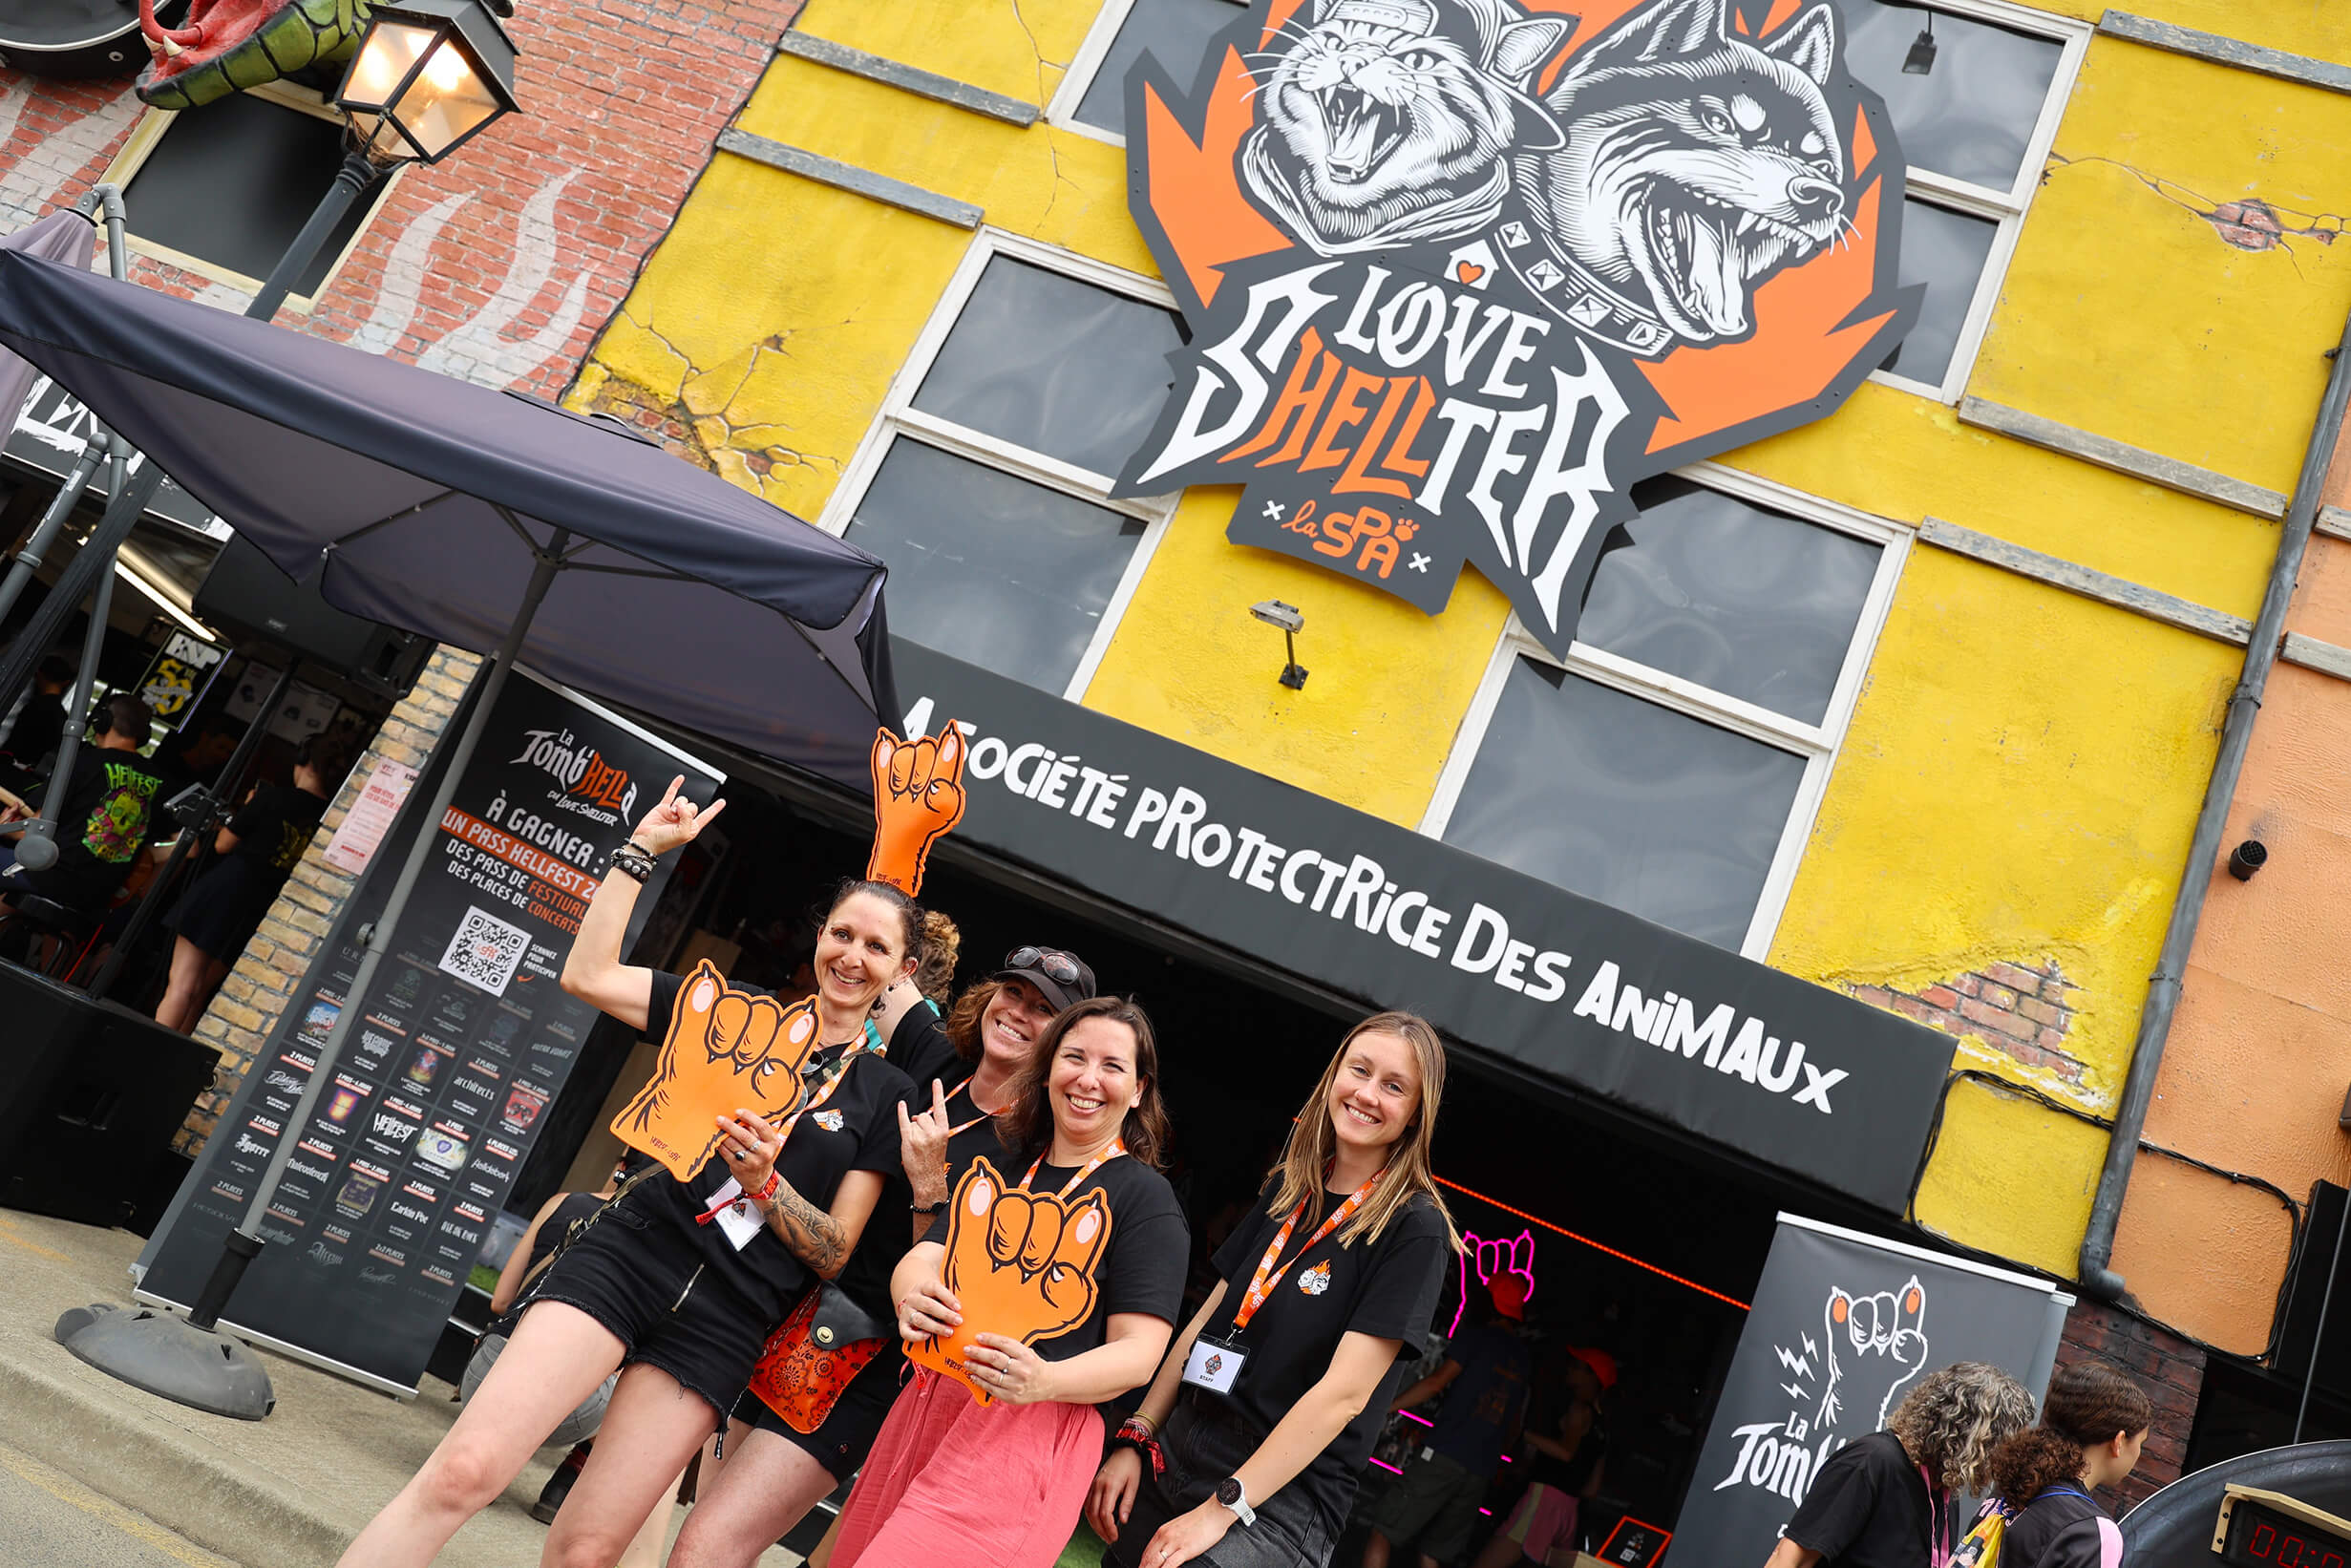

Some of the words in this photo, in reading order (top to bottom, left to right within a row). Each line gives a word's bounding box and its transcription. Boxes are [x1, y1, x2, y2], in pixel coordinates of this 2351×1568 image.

[1334, 264, 1551, 399] LOVE
[1136, 261, 1631, 634] SHELLTER
[1281, 499, 1319, 539] la
[1313, 505, 1401, 579] SPA
[559, 728, 574, 747] La
[485, 789, 507, 823] À
[507, 808, 595, 868] GAGNER
[555, 794, 580, 811] LOVE
[441, 809, 469, 835] UN
[467, 822, 511, 855] PASS
[508, 843, 584, 892] HELLFEST
[446, 837, 475, 862] DES
[473, 853, 510, 879] PASS
[508, 870, 529, 890] DE
[447, 860, 472, 879] DES
[470, 872, 510, 901] PLACES
[511, 890, 529, 909] DE
[527, 901, 582, 936] CONCERTS
[1451, 901, 1572, 1003] DES
[373, 1112, 418, 1143] HELLFEST
[1784, 1410, 1809, 1442] La
